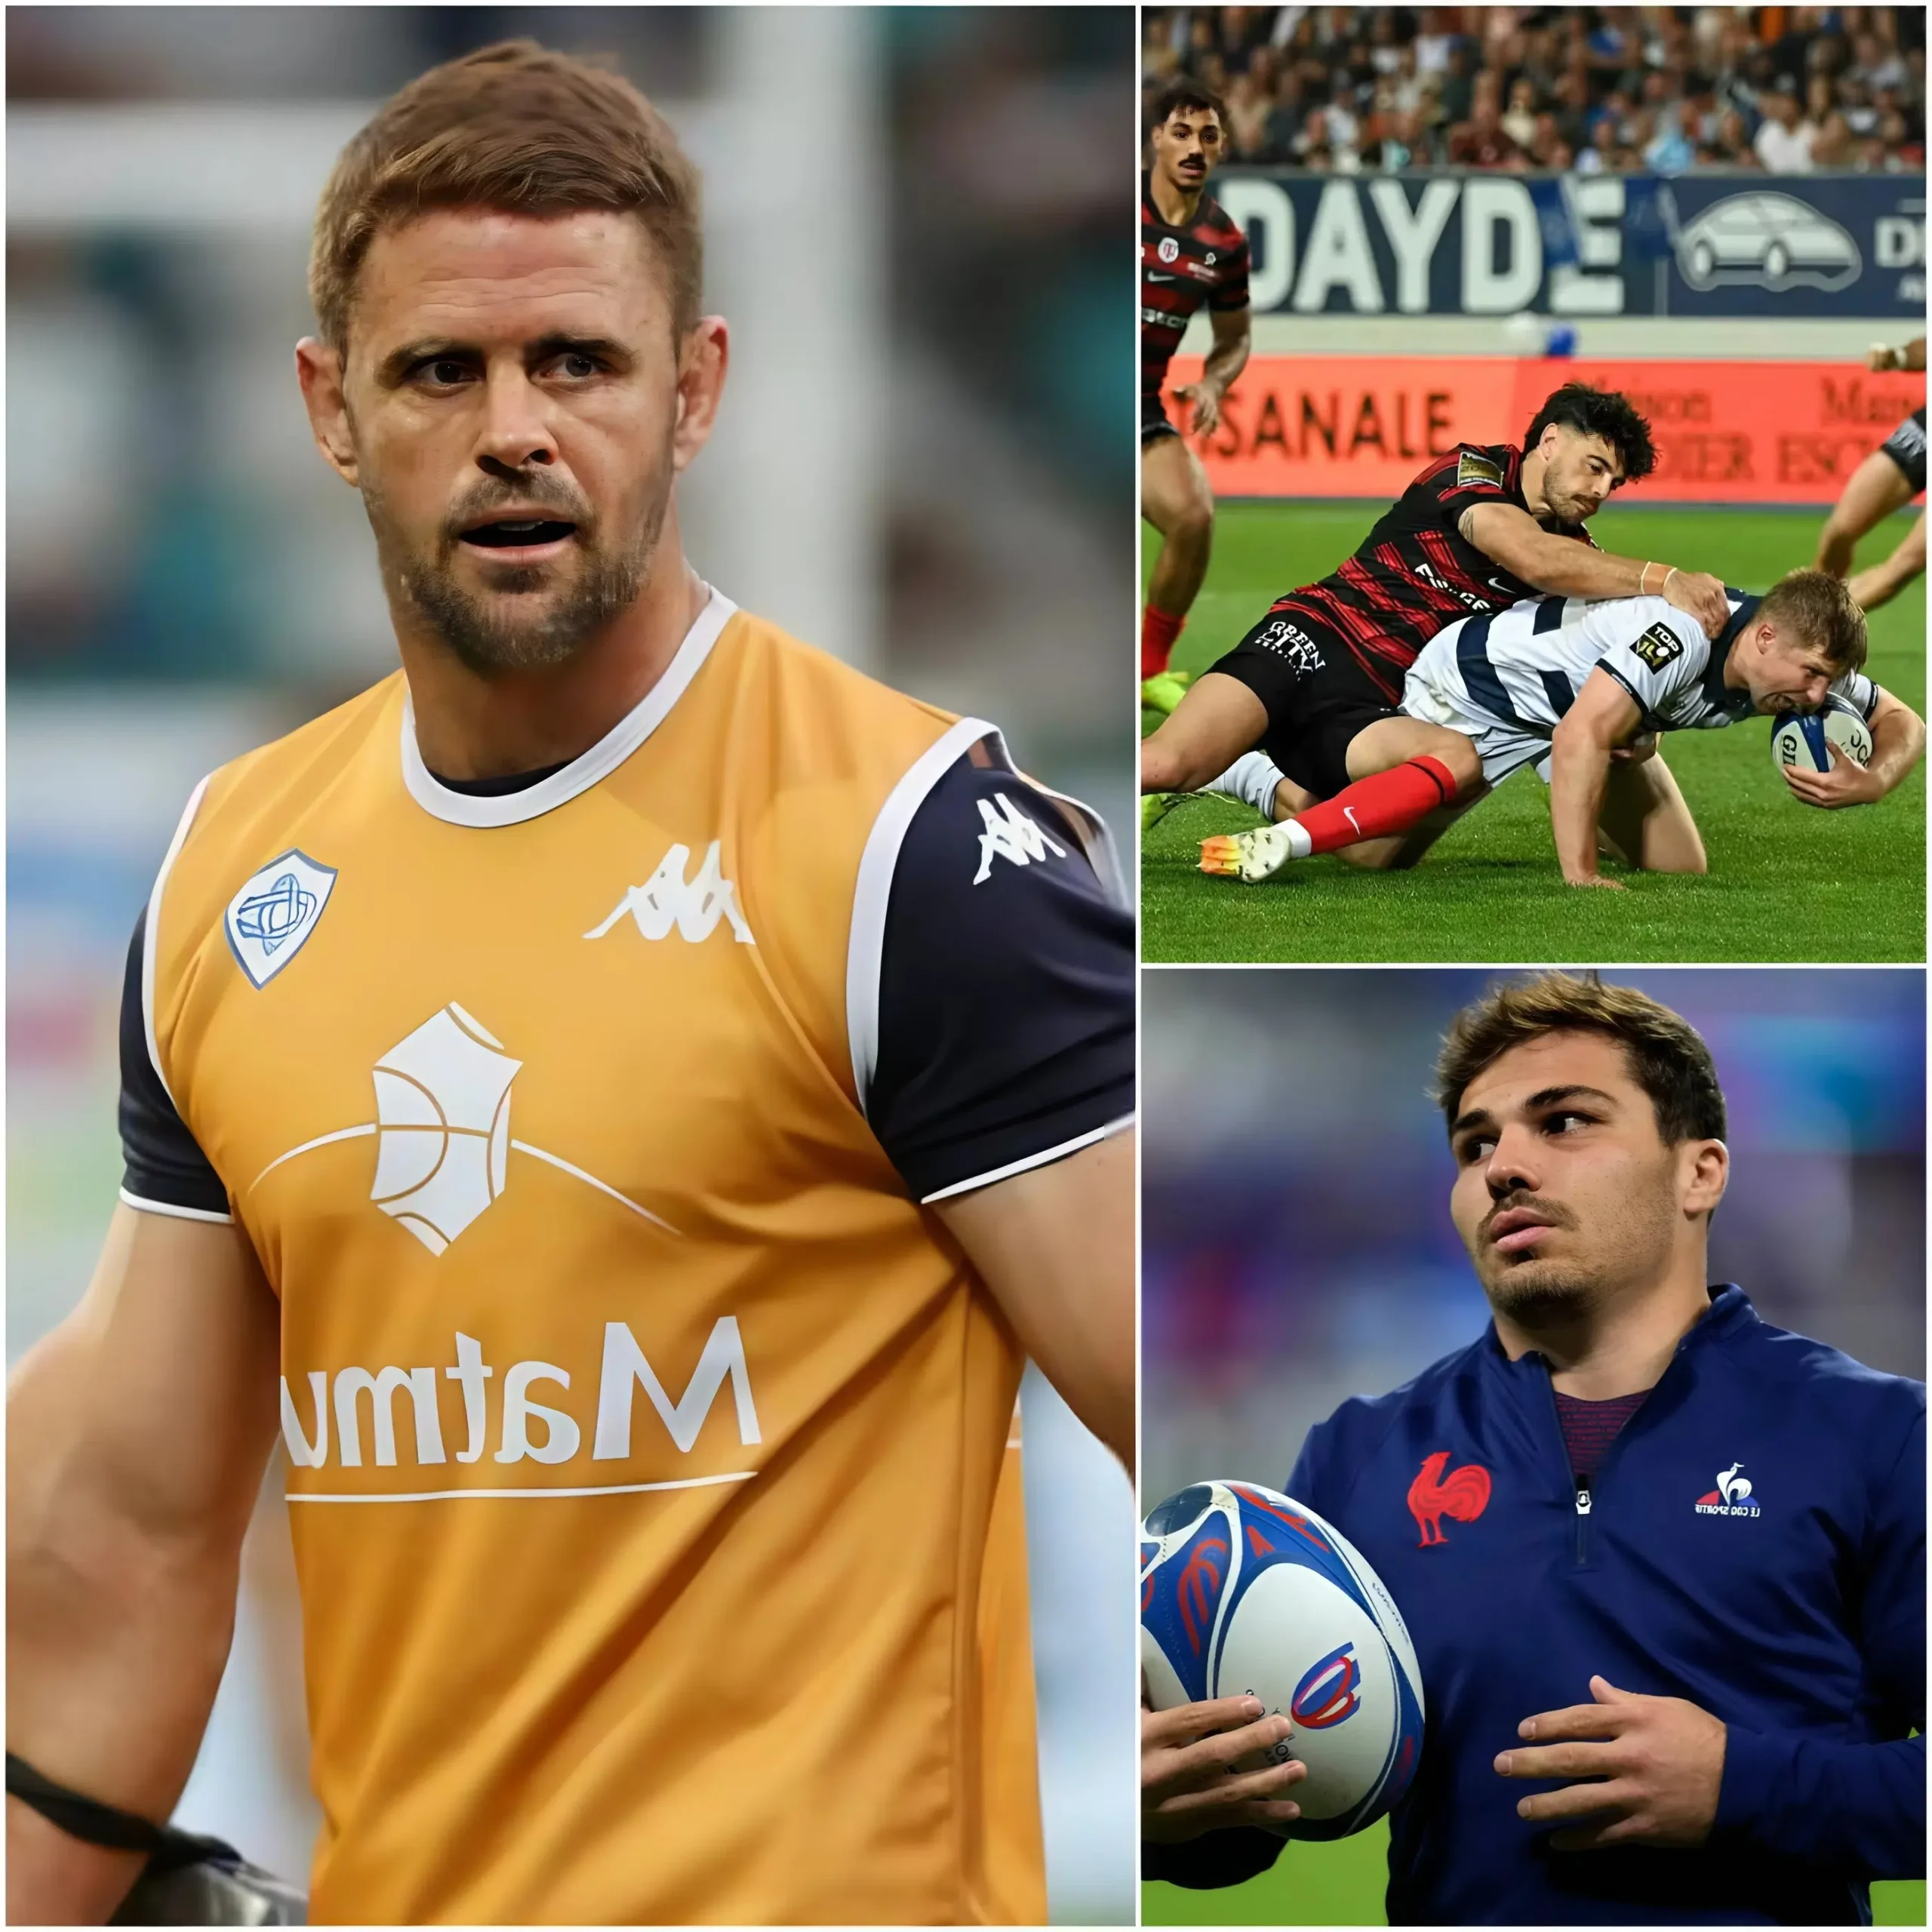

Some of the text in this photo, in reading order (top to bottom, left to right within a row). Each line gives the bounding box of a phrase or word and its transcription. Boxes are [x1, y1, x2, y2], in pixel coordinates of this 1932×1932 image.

[1258, 631, 1313, 672] CITY
[1269, 621, 1326, 669] GREEN
[1654, 626, 1679, 652] TOP
